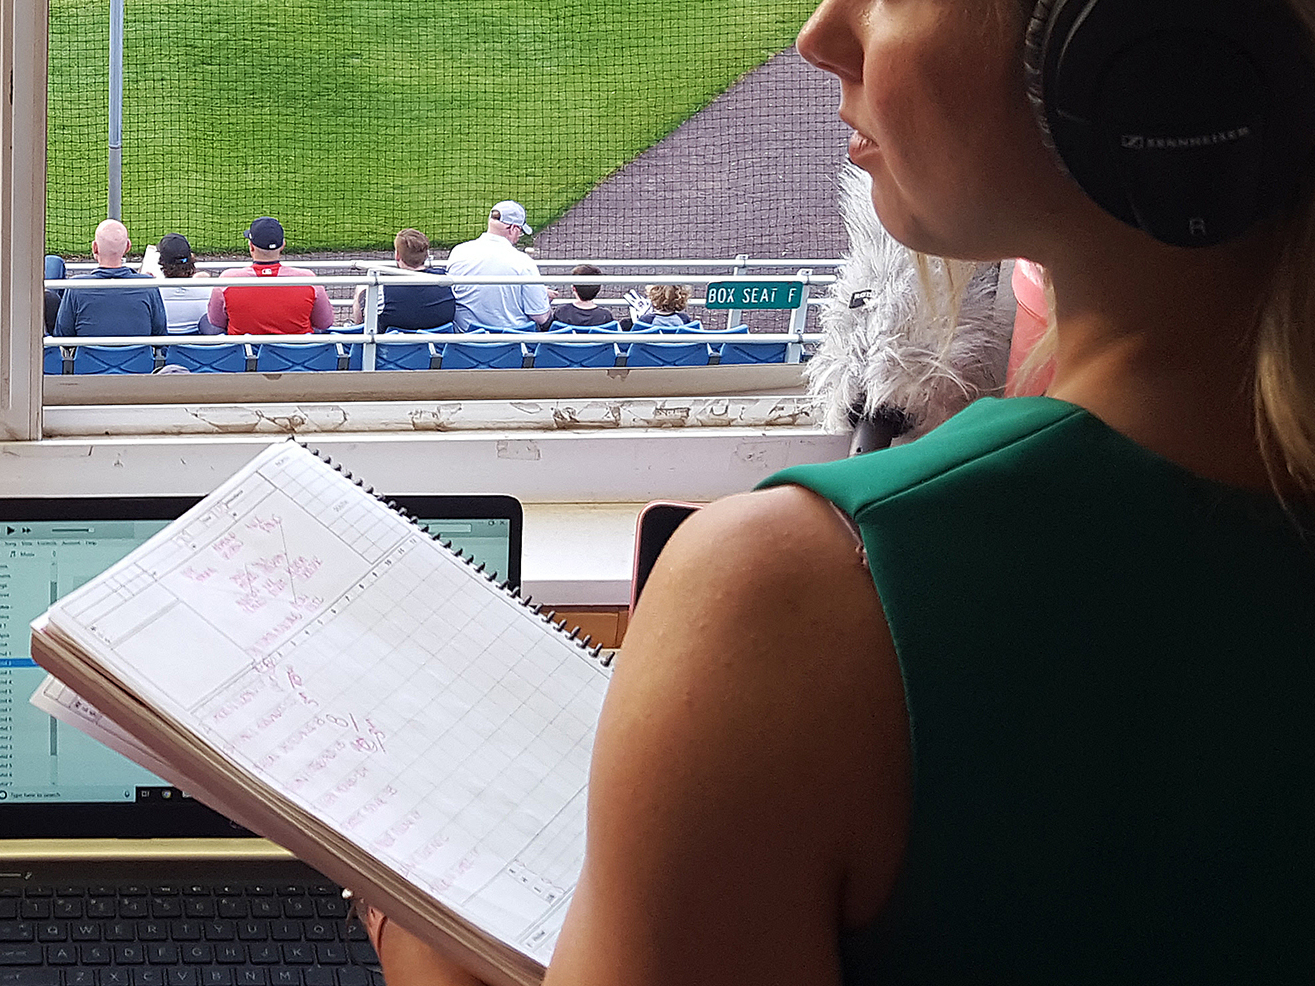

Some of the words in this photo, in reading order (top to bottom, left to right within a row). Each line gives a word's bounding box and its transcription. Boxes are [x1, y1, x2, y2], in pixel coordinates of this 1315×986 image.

[1189, 216, 1207, 236] R
[708, 287, 735, 304] BOX
[742, 287, 778, 304] SEAT
[788, 288, 798, 302] F
